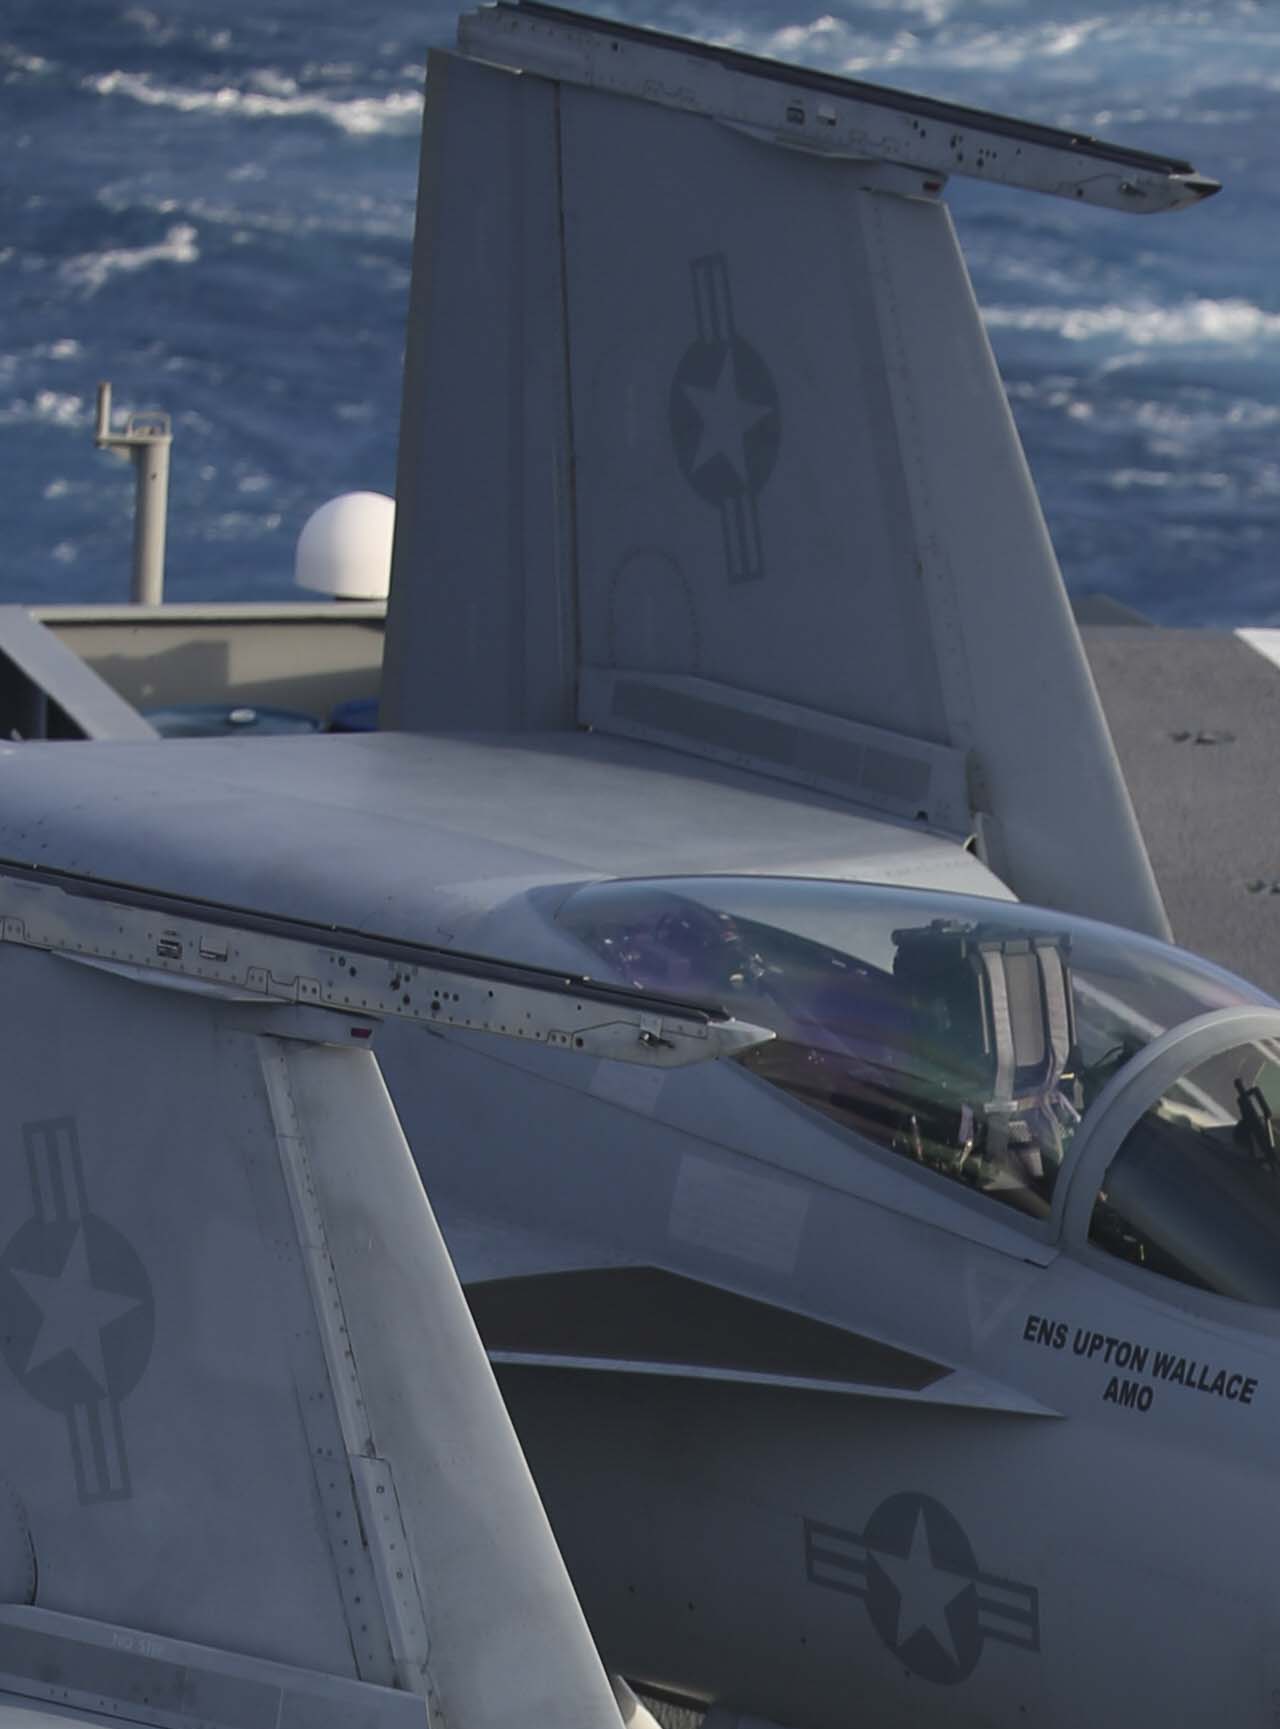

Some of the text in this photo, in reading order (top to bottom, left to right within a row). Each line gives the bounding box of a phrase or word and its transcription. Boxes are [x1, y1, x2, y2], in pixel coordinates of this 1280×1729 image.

[1023, 1314, 1258, 1404] ENS UPTON WALLACE
[1103, 1376, 1154, 1412] AMO
